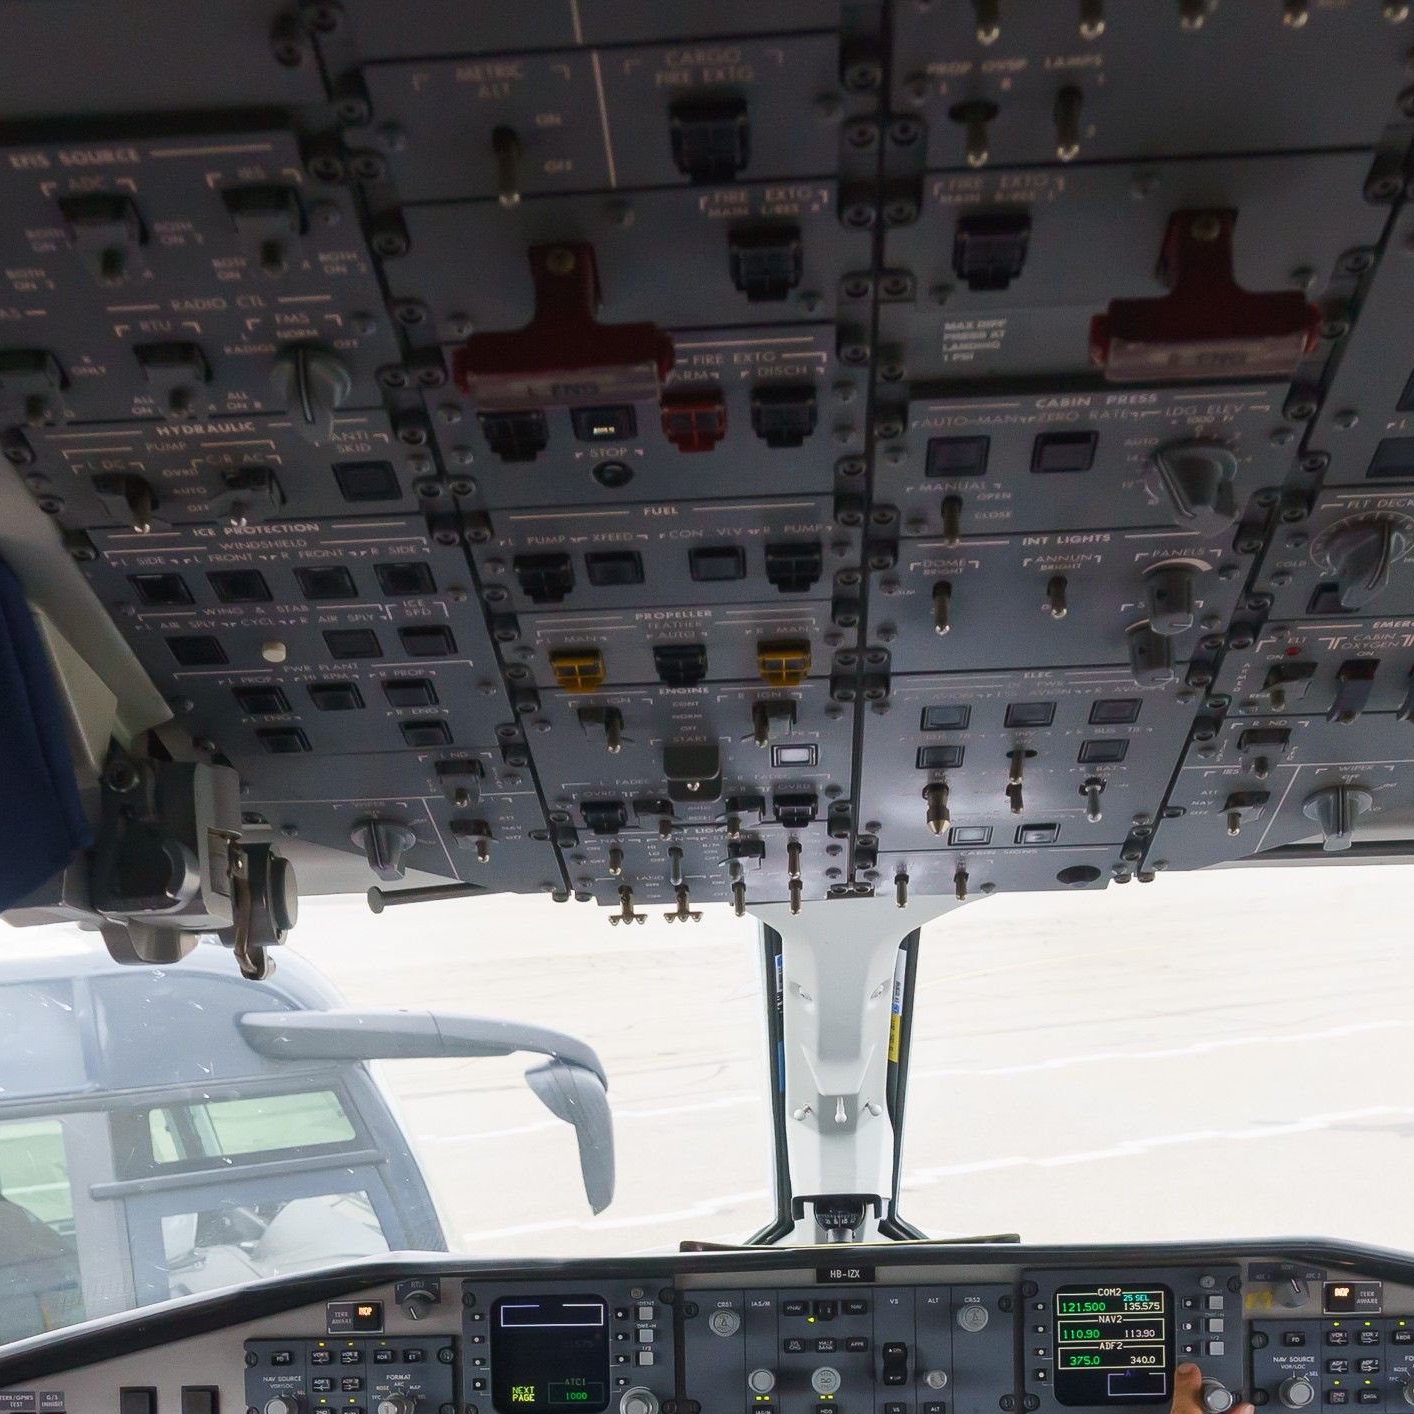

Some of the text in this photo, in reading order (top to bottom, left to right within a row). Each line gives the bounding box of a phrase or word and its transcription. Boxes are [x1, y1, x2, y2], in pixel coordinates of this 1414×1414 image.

[693, 353, 723, 364] FIRE
[757, 365, 808, 377] DISCH
[1035, 392, 1158, 408] CABIN PRESS
[156, 421, 255, 437] HYDRAULIC
[590, 446, 628, 458] STOP
[919, 481, 989, 493] MANUAL
[643, 506, 678, 517] FUEL
[224, 522, 320, 537] PROTECTION
[784, 524, 823, 535] PUMP
[527, 535, 565, 546] PUMP
[592, 532, 634, 543] XFEED
[1022, 532, 1112, 547] INT LIGHTS
[217, 538, 307, 552] WINDSHIELD
[1152, 547, 1206, 558] PANELS
[922, 558, 966, 569] DOME
[1035, 554, 1093, 565] ANNUN
[635, 611, 712, 622] PROPELLER
[659, 685, 709, 696] ENGINE
[830, 1270, 860, 1279] HB-IZX
[1097, 1288, 1122, 1296] COM2
[1062, 1302, 1160, 1312] 121.500 135.575
[1098, 1315, 1123, 1323] NAV2
[1064, 1329, 1155, 1339] 110.90 113.90
[1099, 1342, 1124, 1350] ADF2
[1070, 1356, 1155, 1365] 375.0 340.0
[512, 1386, 535, 1394] NEXT
[512, 1393, 535, 1401] PAGE
[565, 1392, 587, 1400] 1000
